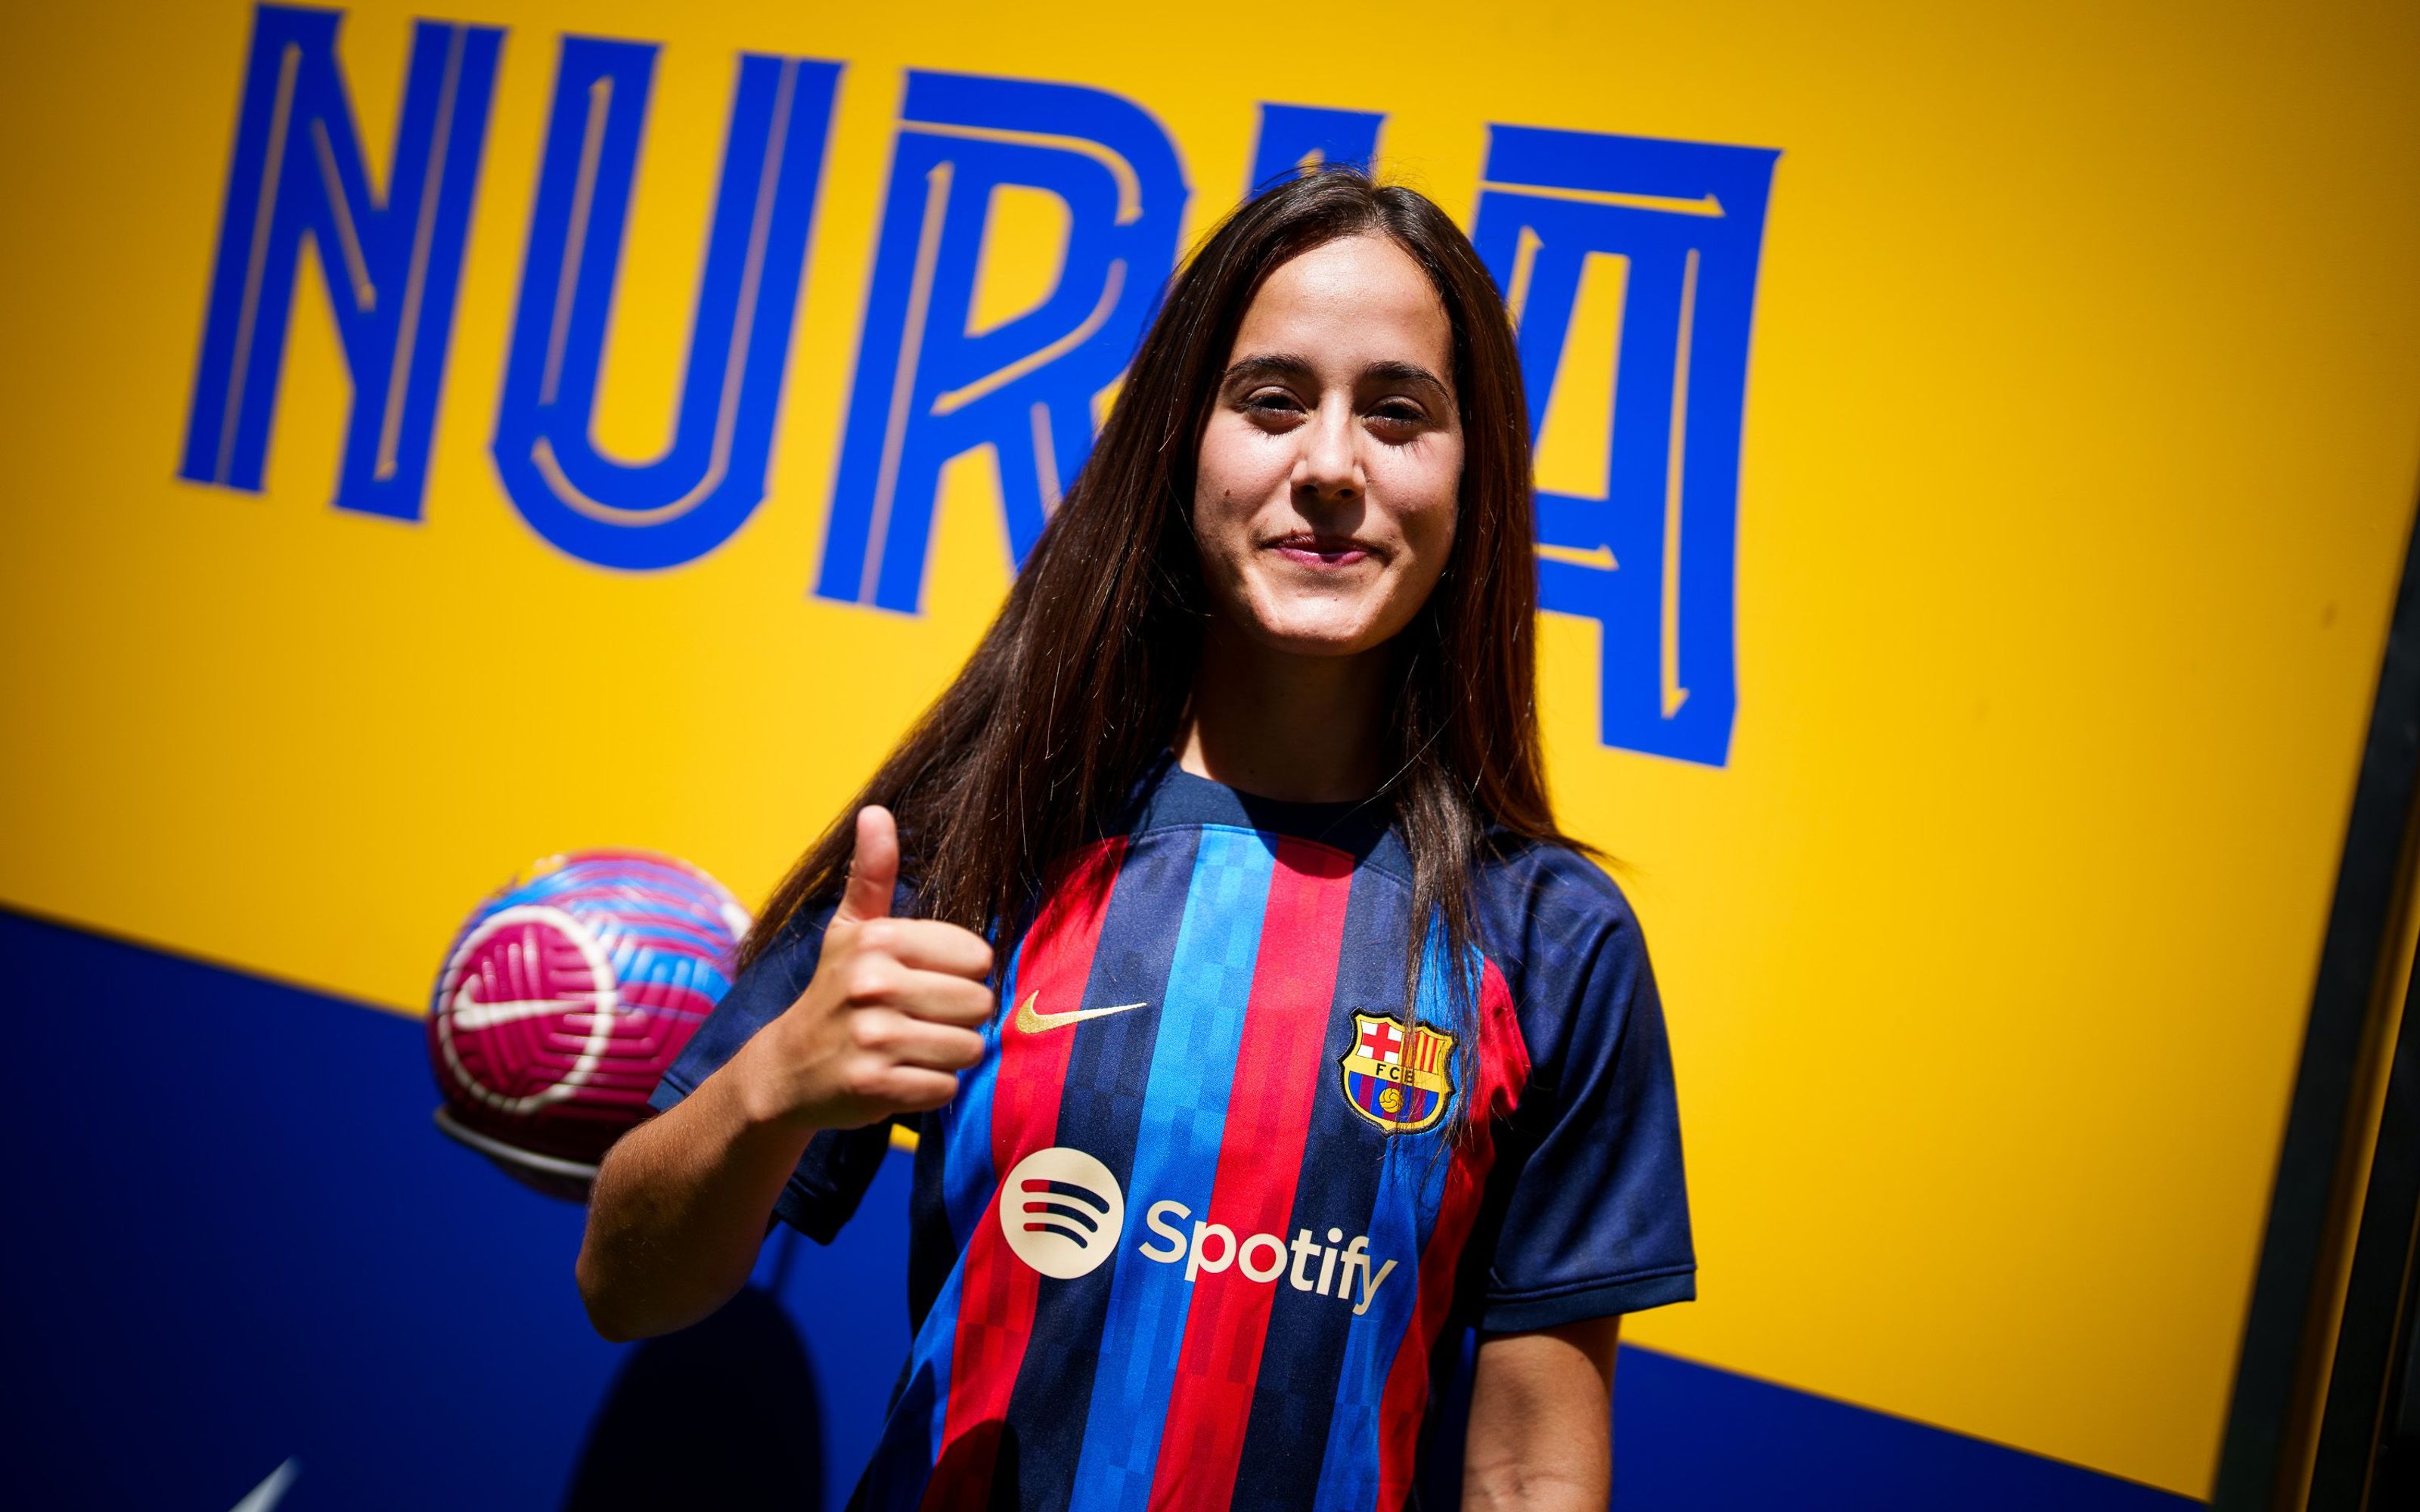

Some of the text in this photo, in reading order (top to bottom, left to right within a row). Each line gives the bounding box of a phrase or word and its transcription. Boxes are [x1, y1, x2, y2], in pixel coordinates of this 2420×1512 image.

[179, 2, 1782, 767] NURA
[1376, 1062, 1415, 1084] FCB
[1138, 1200, 1398, 1315] Spotify
